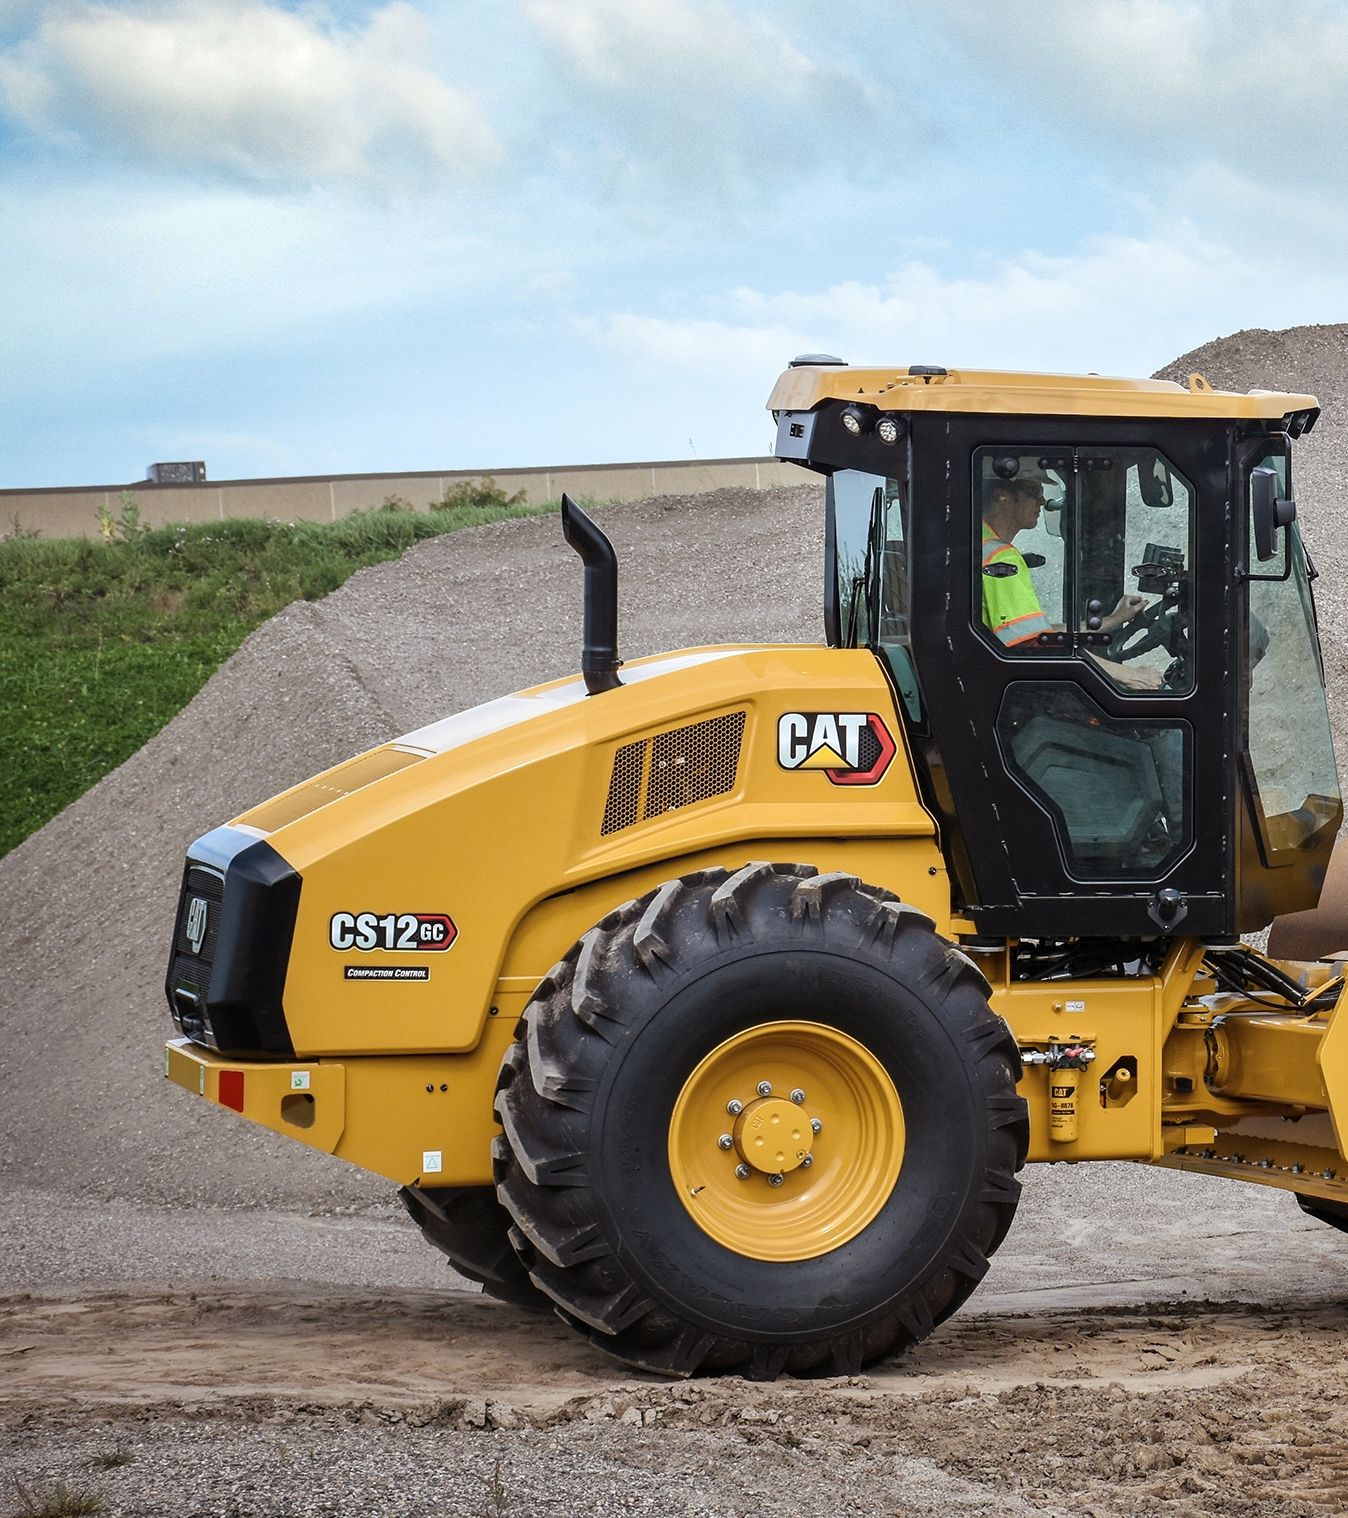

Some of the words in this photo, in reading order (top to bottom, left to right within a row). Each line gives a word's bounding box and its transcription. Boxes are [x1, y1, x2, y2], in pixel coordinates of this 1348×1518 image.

[779, 714, 867, 768] CAT
[331, 913, 418, 949] CS12
[420, 923, 444, 941] GC
[1054, 1087, 1067, 1097] CAT
